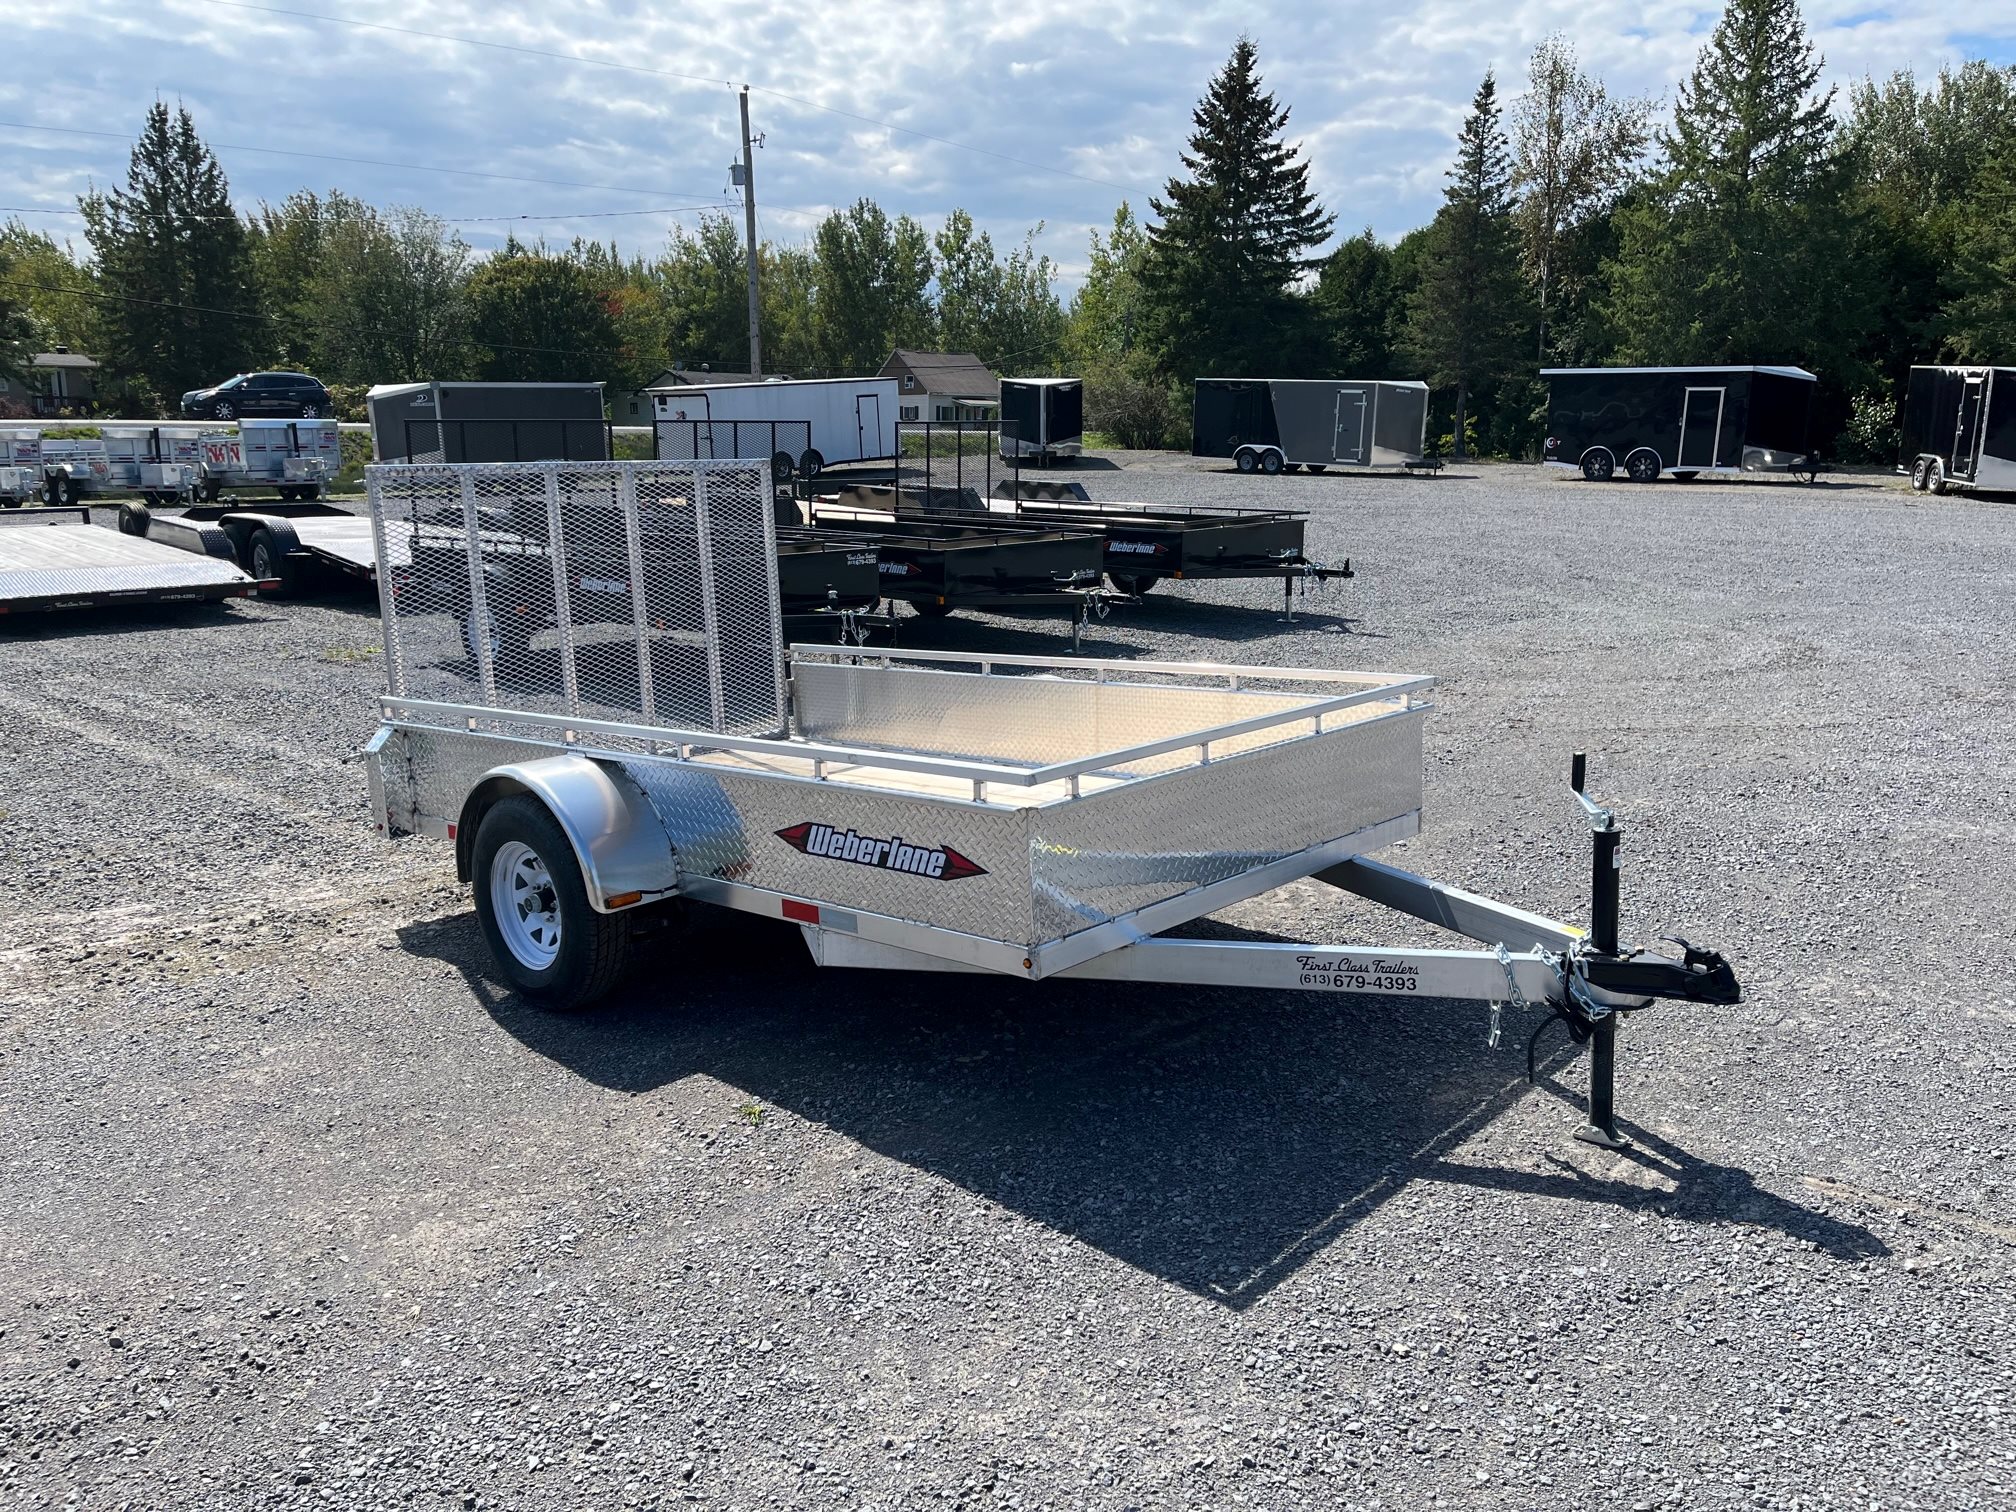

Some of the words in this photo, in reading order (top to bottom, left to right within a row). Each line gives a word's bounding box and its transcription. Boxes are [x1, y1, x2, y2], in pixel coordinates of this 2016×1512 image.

[1108, 540, 1156, 554] Weberlane
[805, 824, 947, 878] Weberlane
[1296, 955, 1334, 971] First
[1333, 957, 1370, 973] Class
[1371, 959, 1420, 975] Trailers
[1299, 973, 1331, 987] (613)
[1333, 974, 1417, 990] 679-4393
